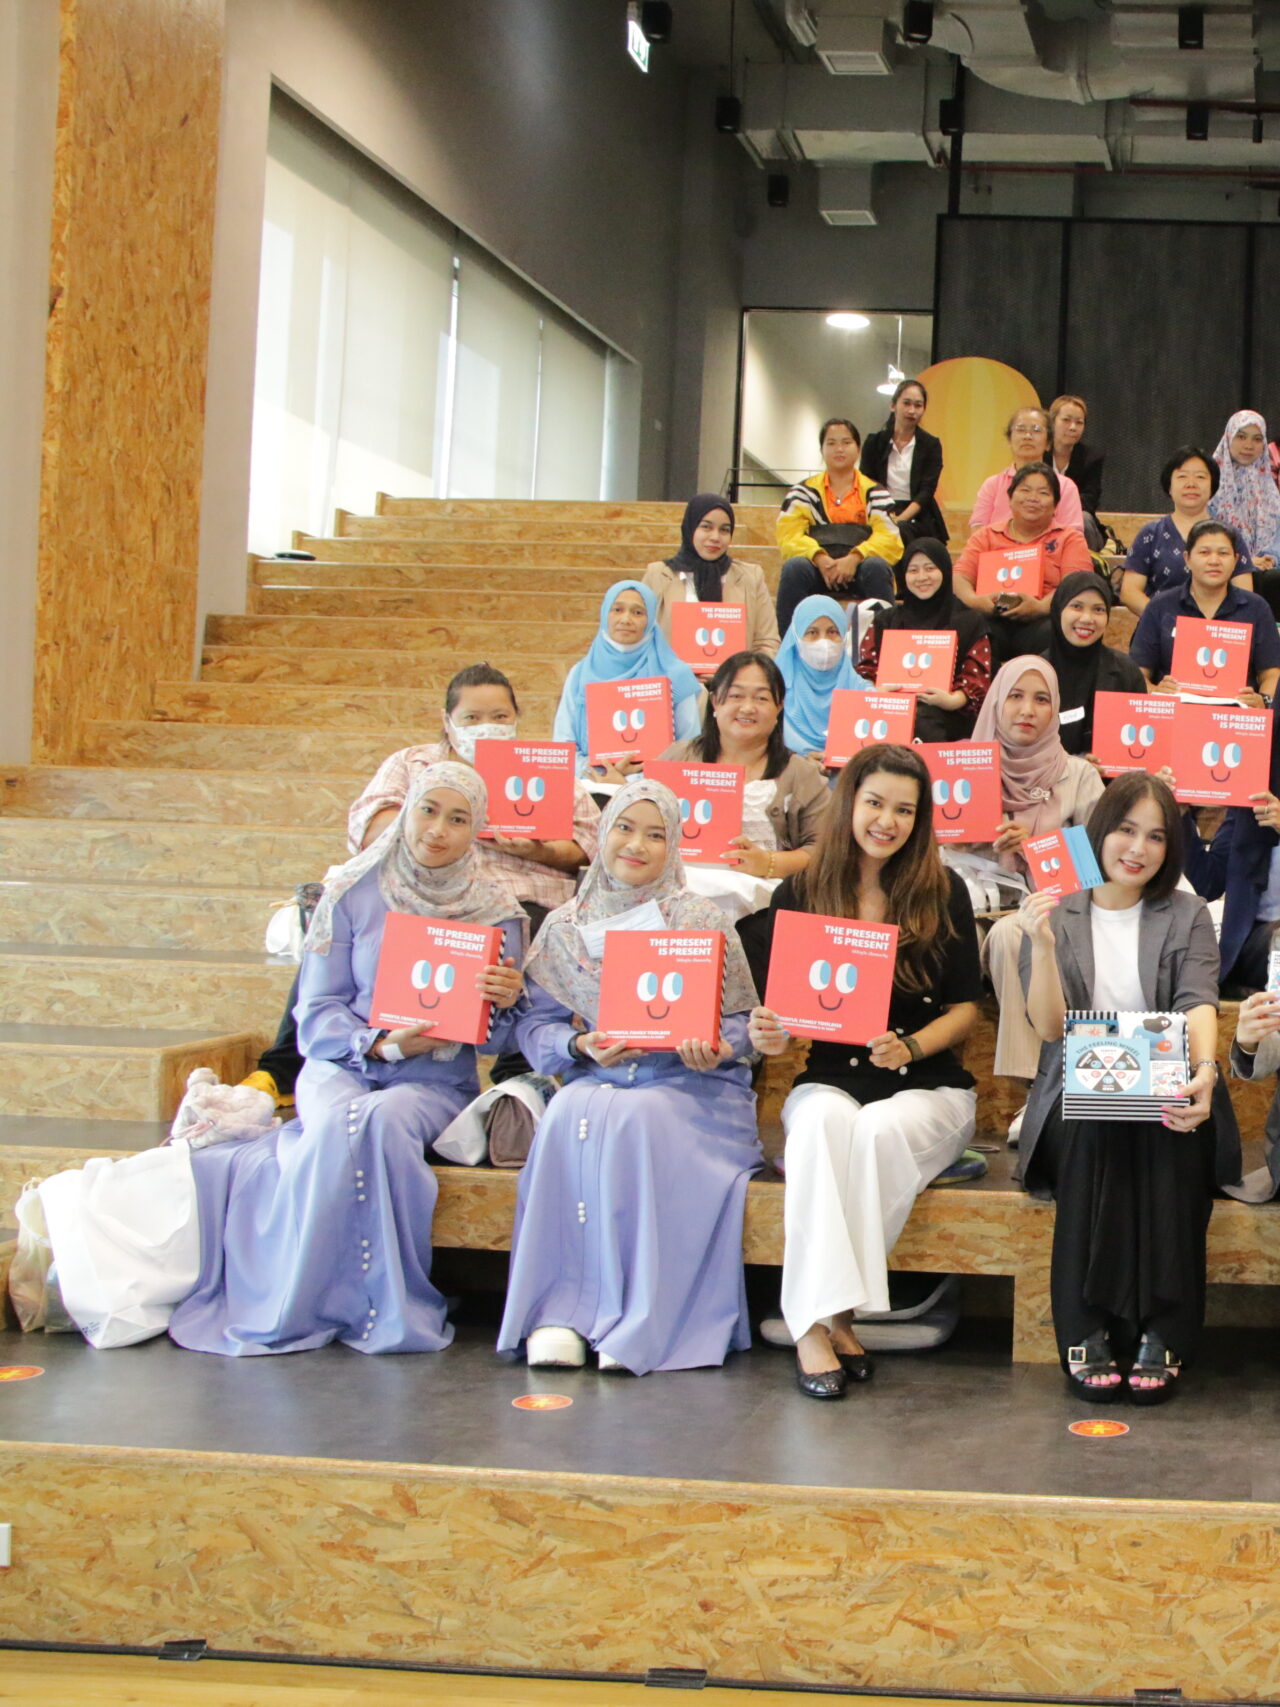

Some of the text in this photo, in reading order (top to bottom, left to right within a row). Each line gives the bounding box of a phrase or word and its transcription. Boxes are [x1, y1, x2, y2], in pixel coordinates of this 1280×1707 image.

[1219, 627, 1247, 635] PRESENT
[1219, 633, 1246, 641] PRESENT
[632, 683, 662, 691] PRESENT
[1230, 723, 1266, 731] PRESENT
[532, 749, 569, 757] PRESENT
[532, 756, 569, 764] PRESENT
[956, 757, 993, 765] PRESENT
[700, 771, 737, 779] PRESENT
[700, 778, 737, 787] PRESENT
[427, 927, 486, 943] THE PRESENT
[825, 925, 891, 941] THE PRESENT
[434, 938, 485, 952] IS PRESENT
[668, 939, 712, 947] PRESENT
[834, 936, 890, 951] IS PRESENT
[670, 948, 712, 956] PRESENT
